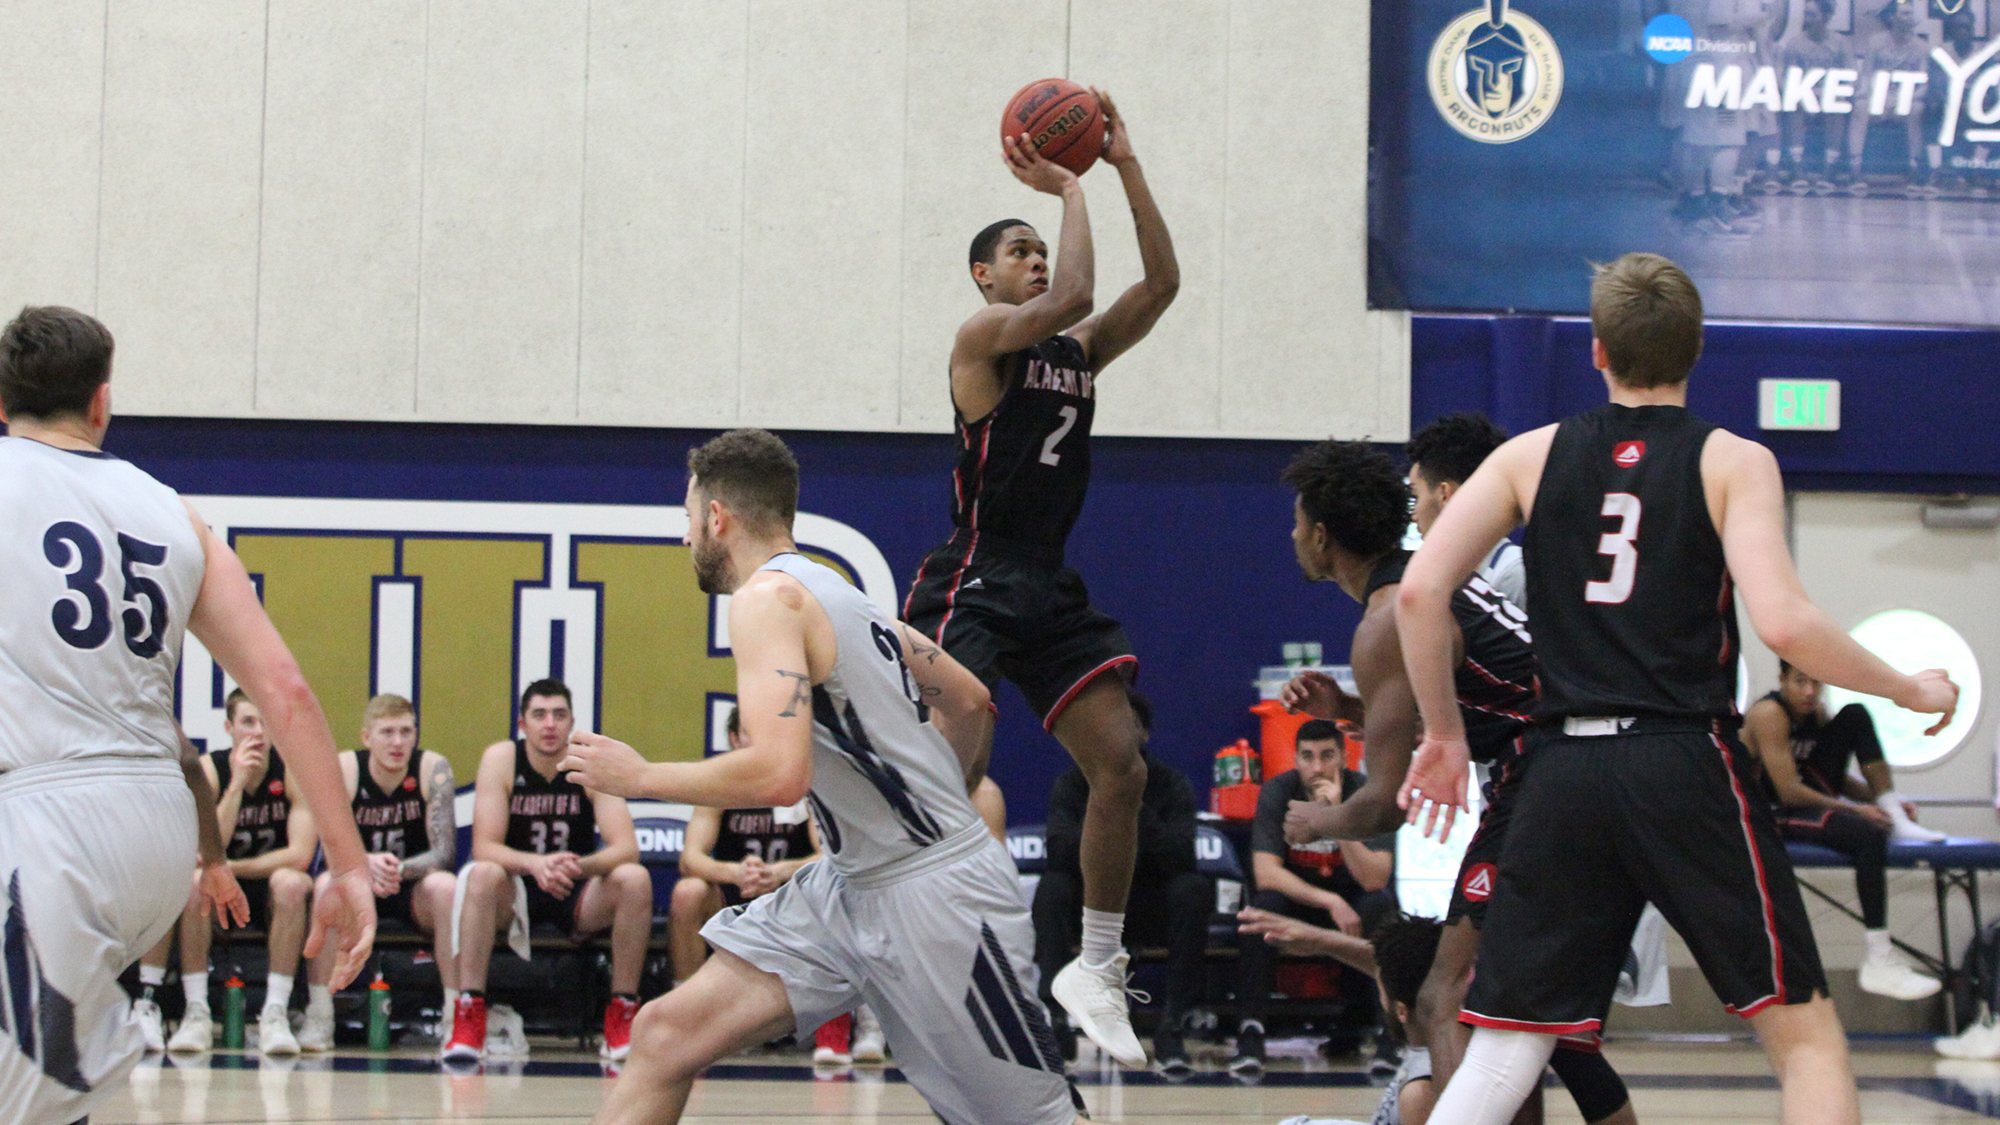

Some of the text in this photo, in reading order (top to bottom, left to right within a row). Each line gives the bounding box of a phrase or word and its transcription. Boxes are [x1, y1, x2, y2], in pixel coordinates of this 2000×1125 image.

[1648, 37, 1692, 52] NCAA
[1684, 63, 1858, 114] MAKE
[1868, 70, 1929, 116] IT
[1448, 102, 1541, 135] ARGONAUTS
[1775, 384, 1829, 426] EXIT
[1039, 405, 1078, 466] 2
[1584, 492, 1641, 604] 3
[43, 520, 168, 660] 35
[530, 820, 570, 855] 33
[635, 828, 685, 852] DNU
